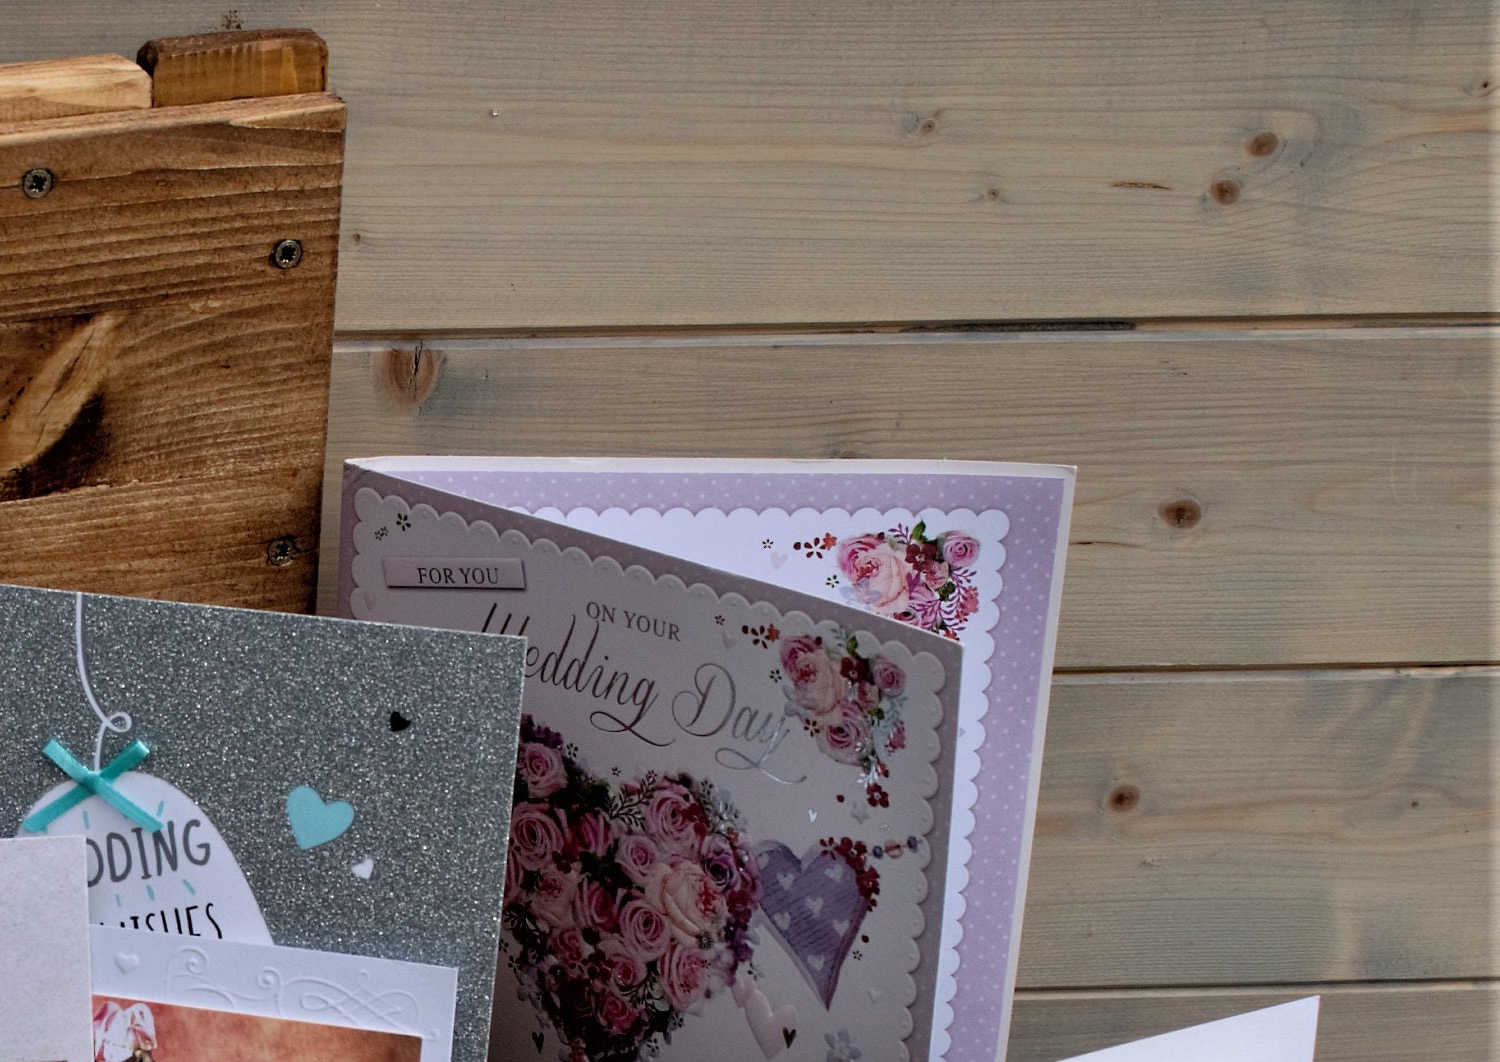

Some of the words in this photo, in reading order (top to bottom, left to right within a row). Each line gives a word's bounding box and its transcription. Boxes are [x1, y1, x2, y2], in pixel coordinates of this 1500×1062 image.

[417, 567, 455, 586] FOR
[458, 567, 499, 586] YOU
[586, 601, 617, 625] ON
[623, 608, 681, 642] YOUR
[672, 662, 808, 785] Day
